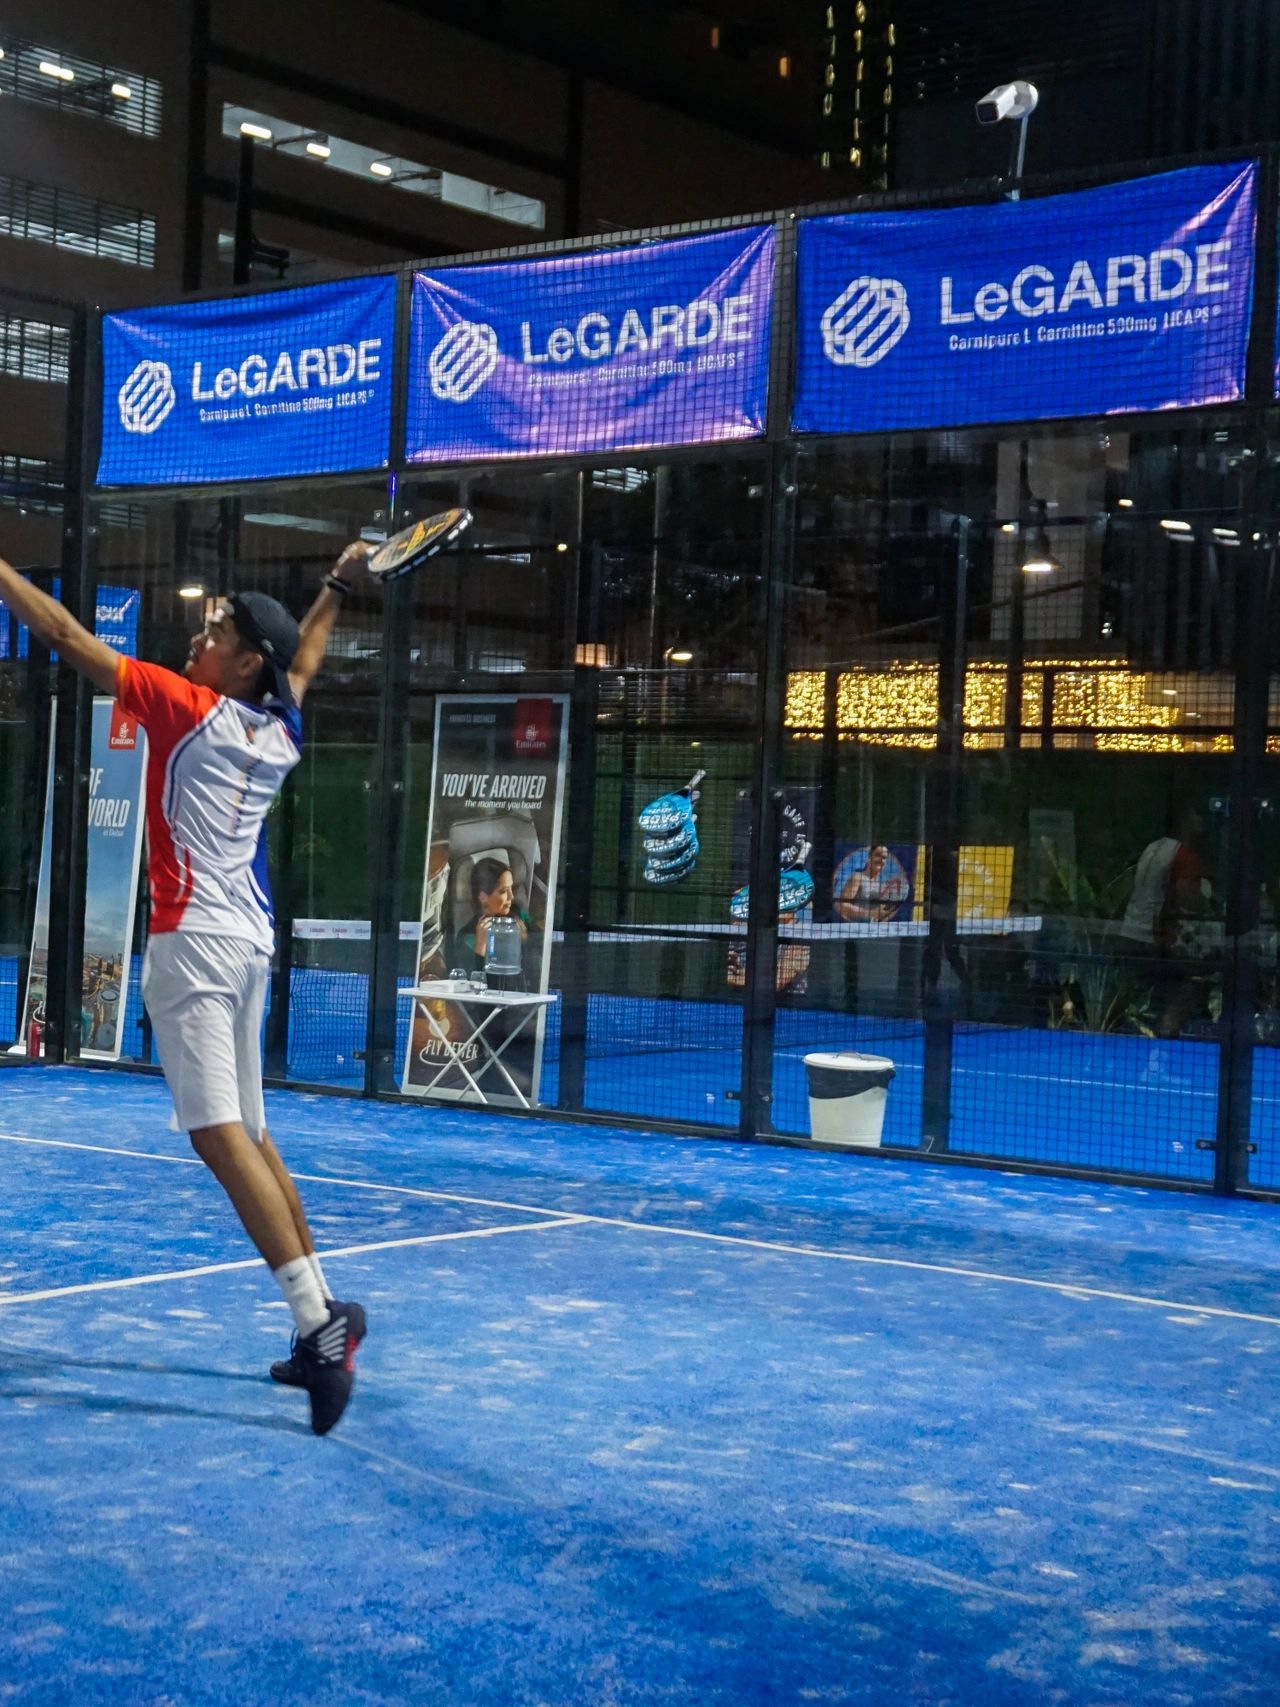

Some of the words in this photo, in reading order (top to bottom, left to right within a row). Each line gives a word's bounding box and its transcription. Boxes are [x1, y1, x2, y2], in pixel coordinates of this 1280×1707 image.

[940, 240, 1231, 325] LeGARDE
[521, 294, 754, 364] LeGARDE
[949, 332, 1020, 350] Carnipure
[1107, 316, 1157, 335] 500mg
[192, 337, 382, 401] LeGARDE
[441, 773, 490, 798] YOU'VE
[489, 775, 547, 799] ARRIVED
[477, 800, 506, 809] moment
[507, 800, 520, 811] you
[521, 800, 543, 810] board
